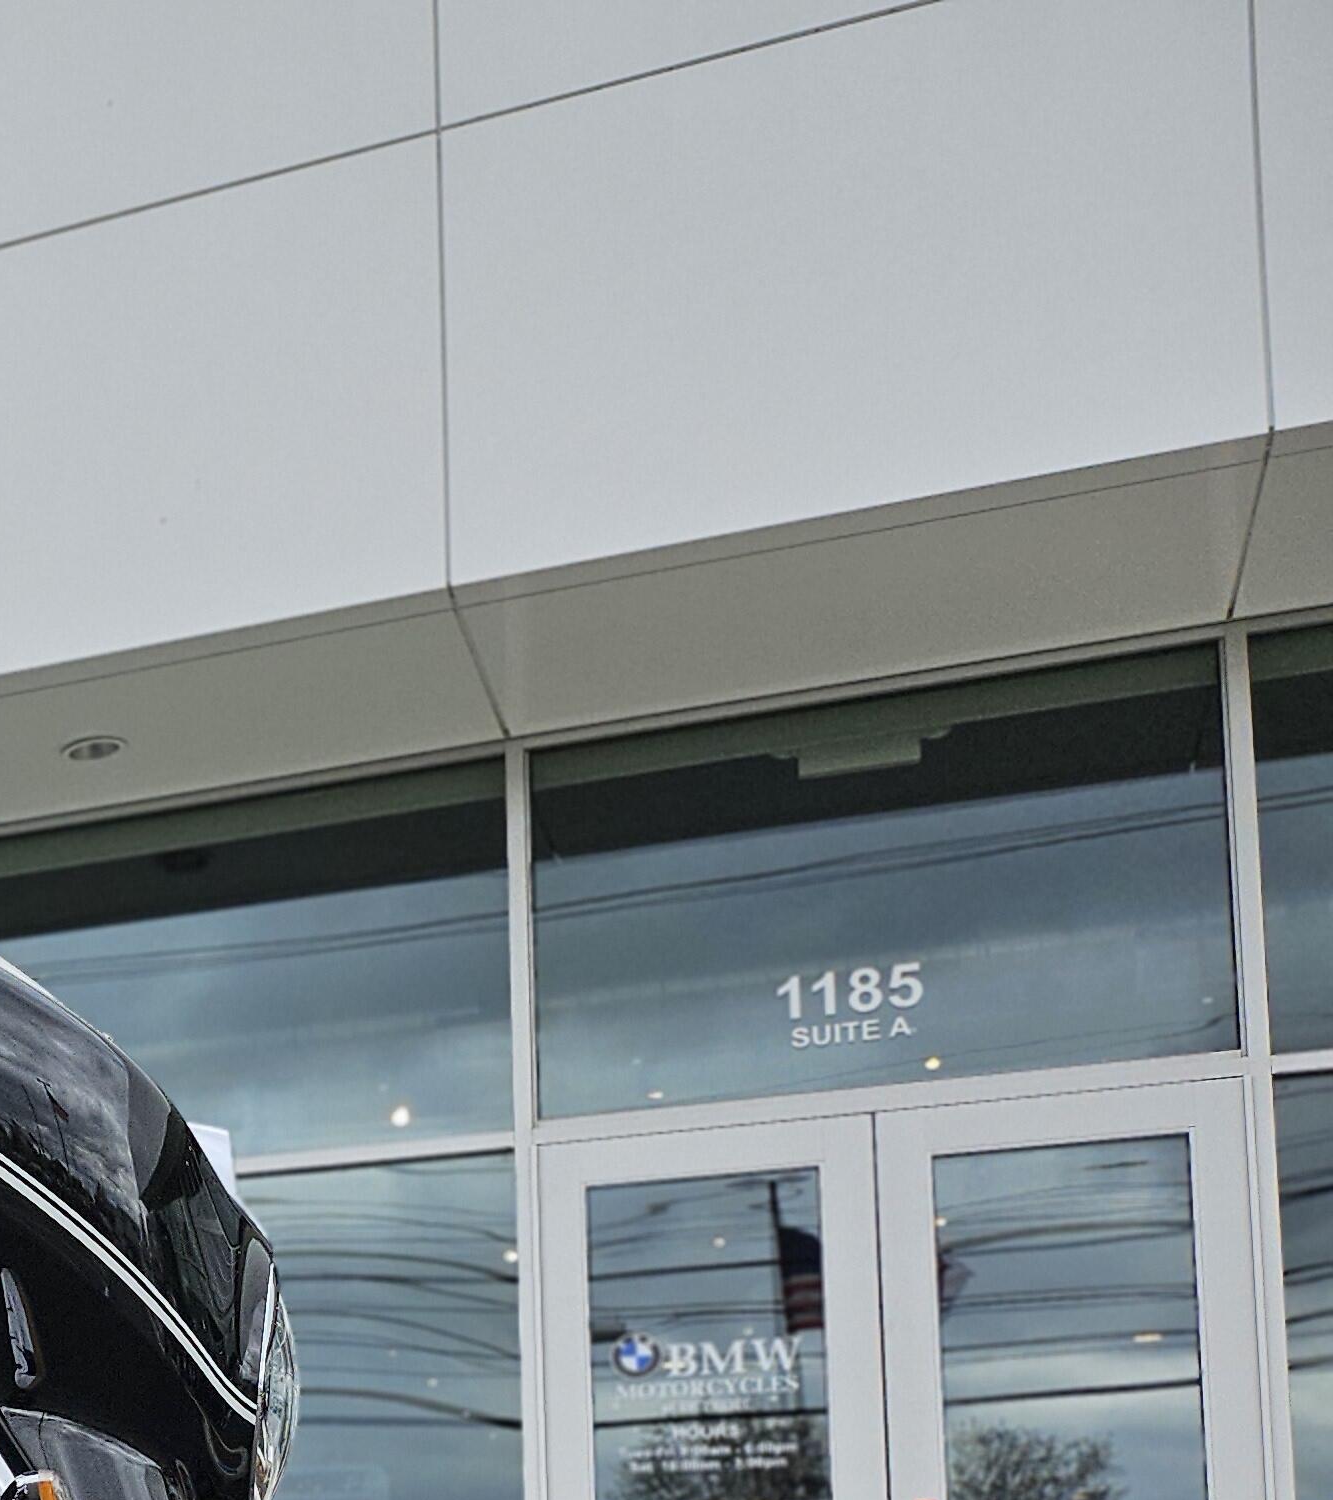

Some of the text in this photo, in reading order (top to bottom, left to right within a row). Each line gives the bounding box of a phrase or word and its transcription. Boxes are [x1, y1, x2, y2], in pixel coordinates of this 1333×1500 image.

[776, 961, 924, 1020] 1185
[790, 1015, 912, 1049] SUITE A
[666, 1335, 803, 1377] BMW
[614, 1374, 800, 1399] MOTORCYCLES
